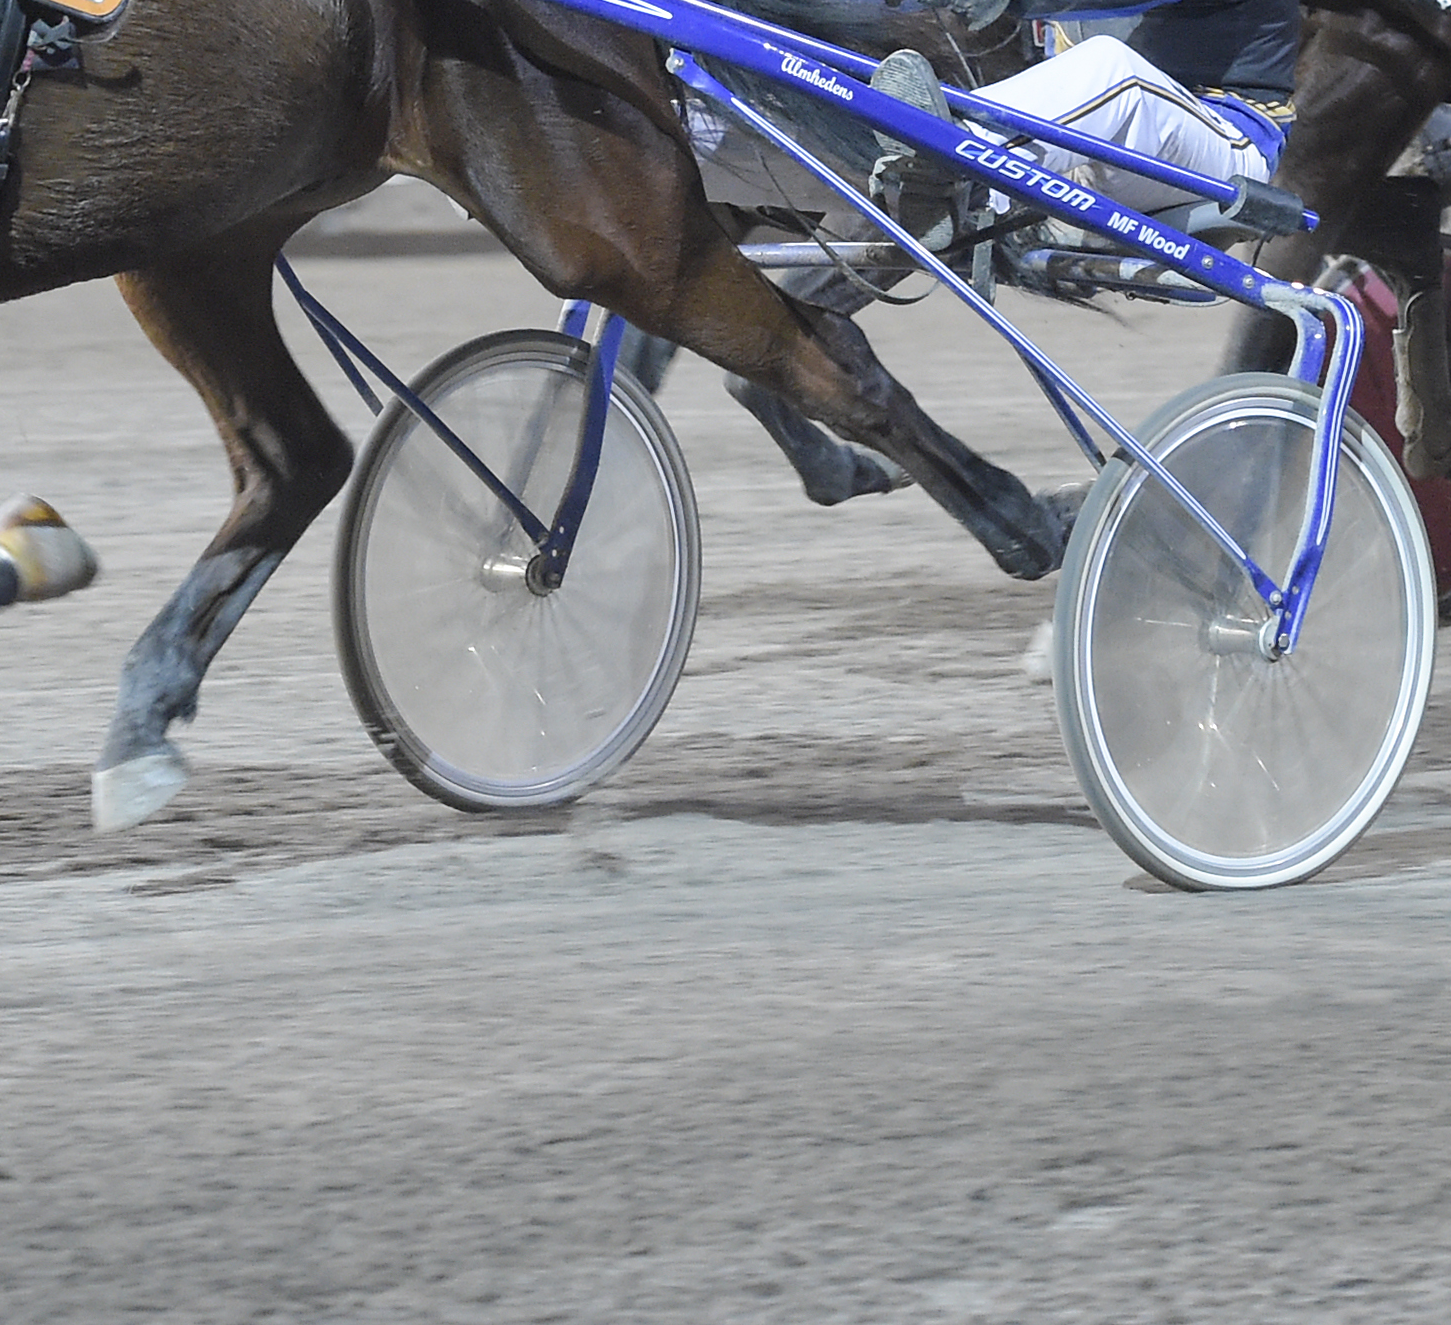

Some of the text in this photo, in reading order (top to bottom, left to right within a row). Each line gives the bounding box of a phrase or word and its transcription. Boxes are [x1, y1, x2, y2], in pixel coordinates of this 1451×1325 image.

[781, 57, 854, 101] Almhedens
[955, 139, 1191, 261] CUSTOM MF Wood
